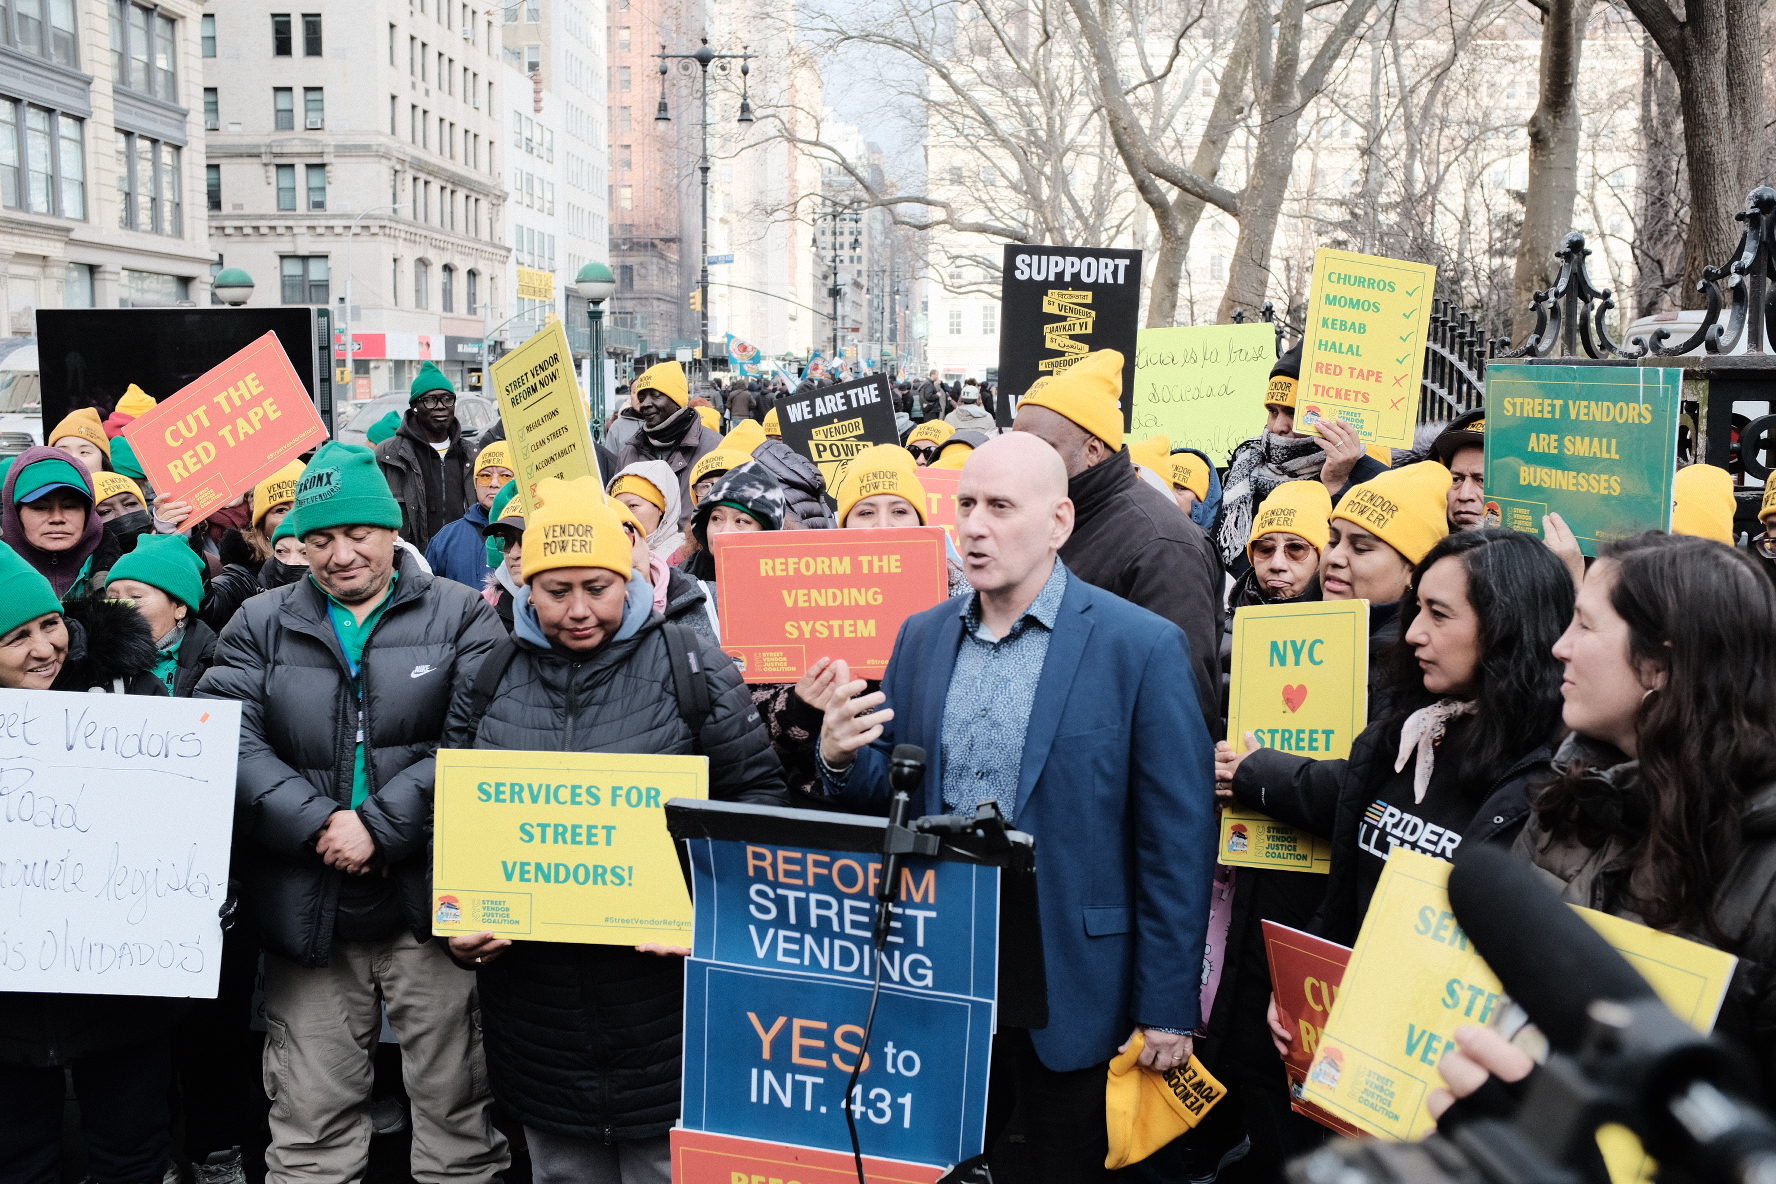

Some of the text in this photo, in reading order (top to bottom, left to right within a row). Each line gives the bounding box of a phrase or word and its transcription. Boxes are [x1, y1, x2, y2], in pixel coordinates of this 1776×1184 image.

[1014, 253, 1130, 284] SUPPORT
[1327, 271, 1396, 293] CHURROS
[1324, 293, 1380, 313] MOMOS
[1050, 323, 1076, 333] MAYKAT
[1079, 321, 1088, 331] YI
[1321, 316, 1367, 335] KEBAB
[1317, 339, 1362, 357] HALAL
[504, 352, 560, 396] STREET VENDOR
[1314, 361, 1383, 383] RED TAPE
[510, 368, 561, 408] REFORM NOW!
[1313, 384, 1370, 404] TICKETS
[165, 371, 264, 447] CUT THE
[786, 383, 880, 423] WE ARE THE
[1338, 409, 1361, 418] STREET
[1503, 397, 1652, 424] STREET VENDORS
[526, 408, 560, 433] REGULATIONS
[822, 420, 861, 439] VENDOR
[166, 397, 282, 483] RED TAPE
[266, 425, 317, 460] #StreetVendorReform
[530, 425, 569, 453] CLEAN STREETS
[1527, 432, 1620, 459] ARE SMALL
[481, 459, 503, 467] POWER!
[482, 451, 504, 460] VENDOR
[534, 442, 577, 472] ACCOUNTABILITY
[697, 455, 724, 468] VENDOR
[696, 462, 723, 476] POWER!
[859, 470, 898, 484] VENDOR
[298, 471, 333, 495] BRONX
[859, 481, 898, 496] POWER!
[1519, 466, 1621, 496] BUSINESSES
[1344, 499, 1387, 529] POWER!
[1356, 487, 1399, 519] VENDOR
[1513, 507, 1530, 515] STREET
[1257, 517, 1294, 532] POWER!
[1260, 507, 1297, 522] VENDOR
[1513, 513, 1532, 521] VENDOR
[543, 524, 593, 539] VENDOR
[1513, 525, 1539, 534] COALITION
[543, 539, 592, 557] POWER!
[759, 554, 902, 576] REFORM THE
[781, 587, 883, 607] VENDING
[784, 619, 876, 639] SYSTEM
[1269, 638, 1324, 667] NYC
[415, 665, 431, 673] NIKE
[64, 705, 202, 759] Vendors
[1254, 728, 1335, 752] STREET
[477, 781, 662, 809] SERVICES FOR
[519, 822, 616, 847] STREET
[1254, 825, 1265, 857] NYC
[1266, 826, 1293, 835] STREET
[1266, 835, 1298, 844] VENDOR
[1377, 804, 1463, 858] RIDER
[1265, 843, 1297, 852] JUSTICE
[1265, 851, 1308, 861] COALITION
[501, 860, 634, 887] VENDORS!
[604, 916, 692, 927] #StreetVendorReform
[749, 924, 933, 987] VENDING
[746, 1011, 921, 1077] YES to
[1365, 1078, 1396, 1099] VENDOR
[1367, 1069, 1395, 1087] STREET
[750, 1068, 913, 1129] INT. 431
[1162, 1067, 1205, 1116] VENDOR
[1361, 1087, 1393, 1108] JUSTICE
[1357, 1096, 1401, 1122] COALITION
